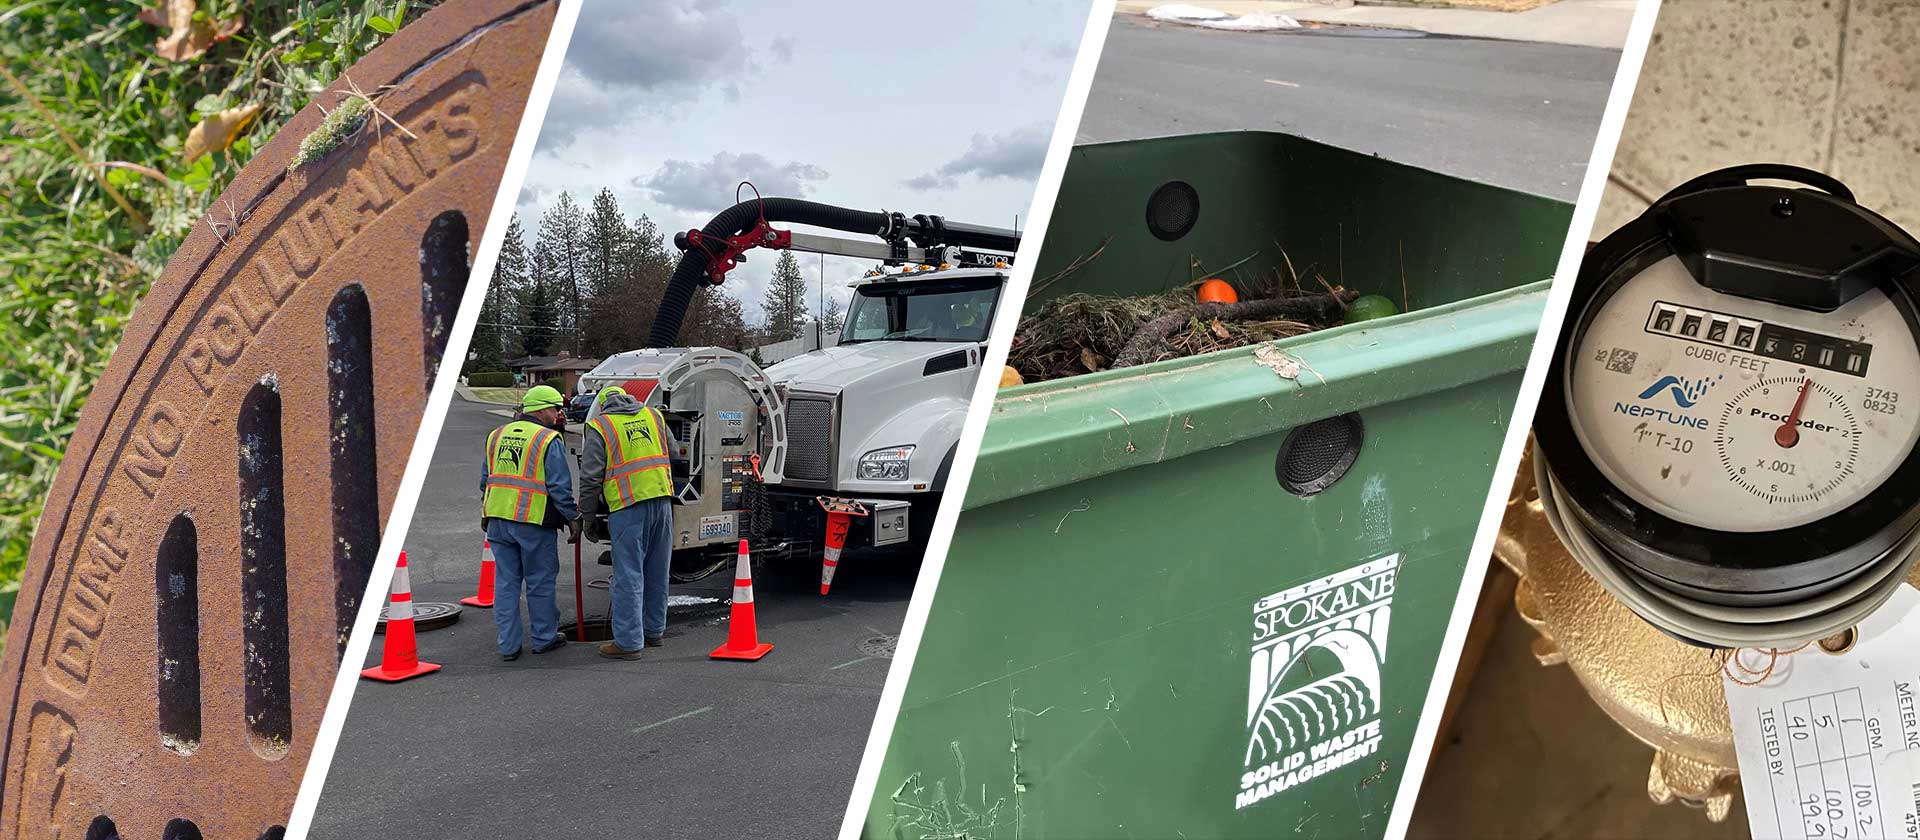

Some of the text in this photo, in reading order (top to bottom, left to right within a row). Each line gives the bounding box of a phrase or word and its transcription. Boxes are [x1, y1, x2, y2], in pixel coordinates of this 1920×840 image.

[1684, 345, 1771, 374] CUBIC FEET
[54, 97, 480, 686] DUMP NO POLLUTANTS
[1763, 388, 1770, 396] 9
[1866, 387, 1899, 403] 3743
[1736, 407, 1743, 415] 8
[1828, 401, 1833, 409] 1
[1863, 399, 1897, 415] 0823
[1655, 433, 1694, 454] T-10
[1841, 430, 1849, 438] 2
[1740, 467, 1747, 475] 6
[1768, 460, 1796, 476] .001
[1835, 461, 1842, 469] 3
[1257, 557, 1394, 610] CITY OF
[1253, 568, 1396, 642] SPOKANE
[1898, 682, 1916, 729] METER
[1787, 716, 1809, 740] 40
[1814, 715, 1834, 728] 5
[1761, 708, 1784, 776] TESTED BY
[1867, 717, 1883, 749] GPM
[1241, 718, 1382, 791] SOLID WASTE
[1236, 734, 1383, 811] MANAGEMENT
